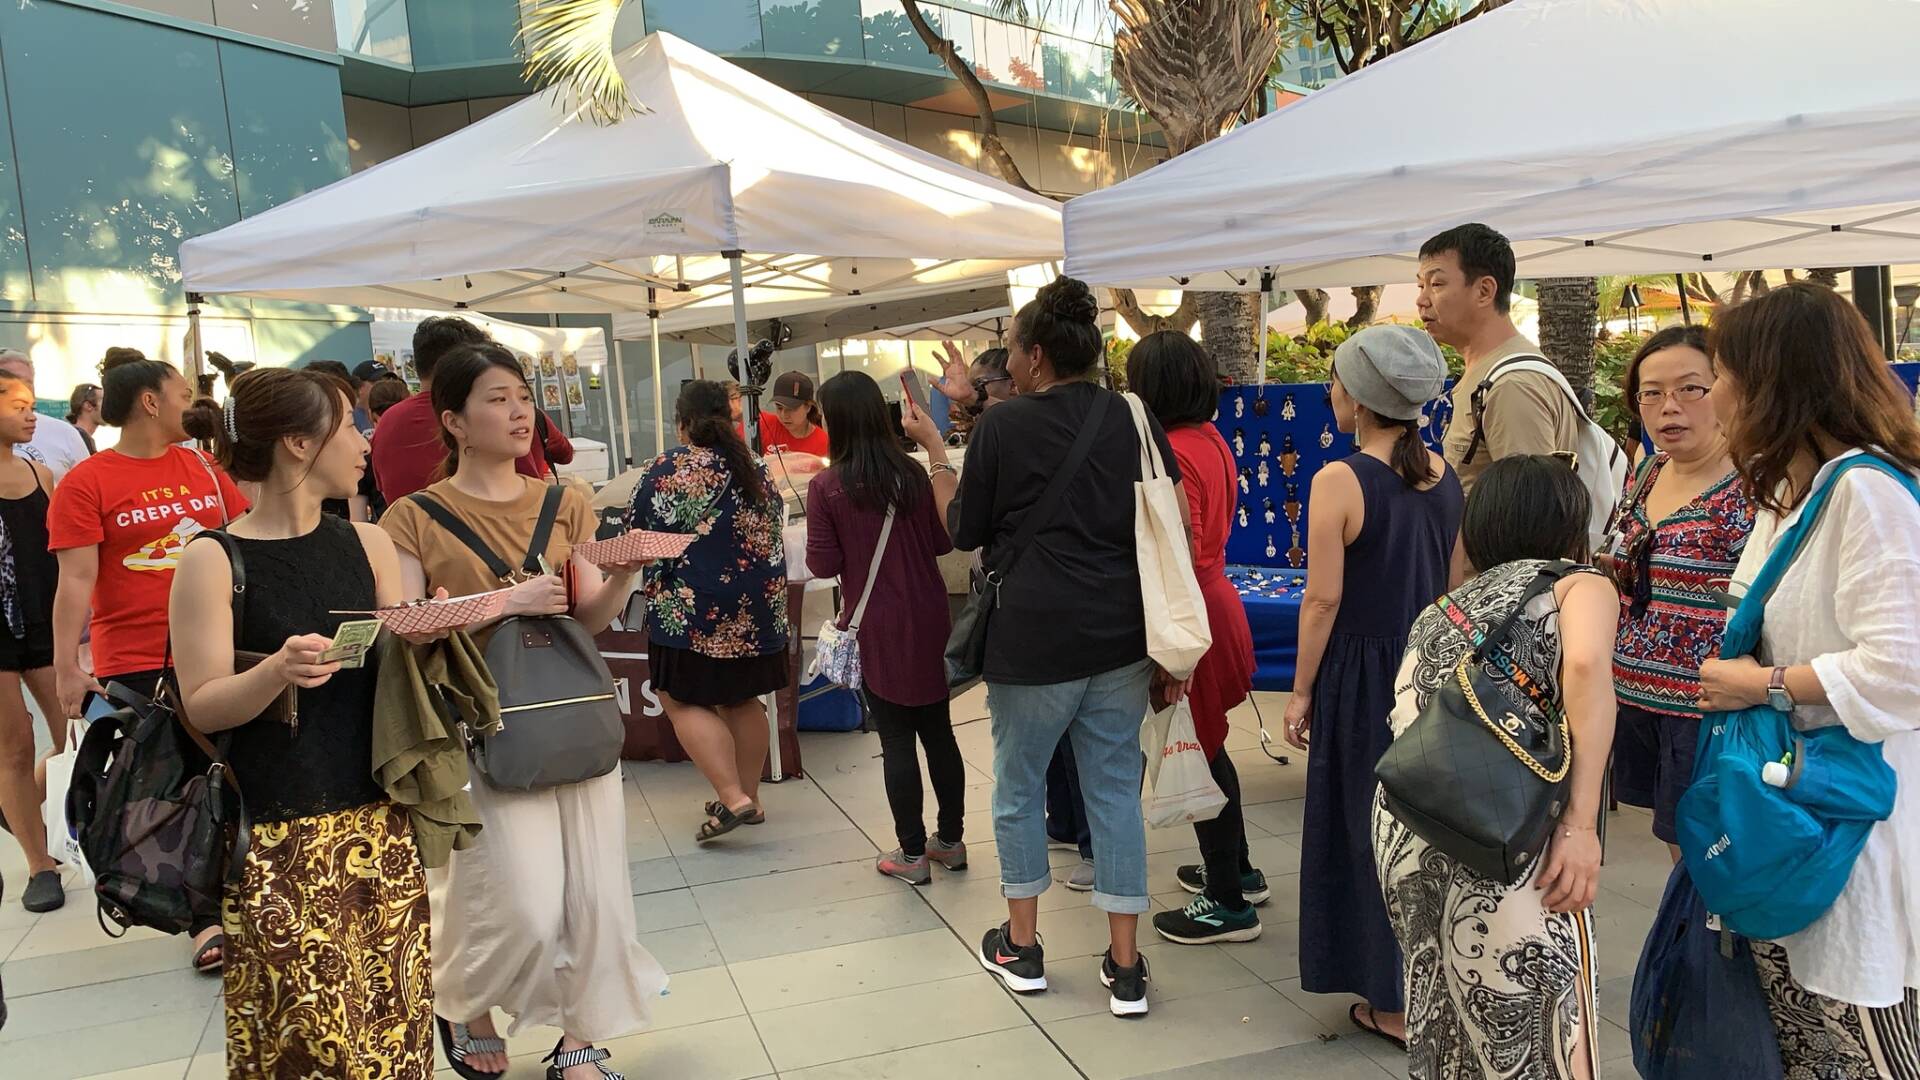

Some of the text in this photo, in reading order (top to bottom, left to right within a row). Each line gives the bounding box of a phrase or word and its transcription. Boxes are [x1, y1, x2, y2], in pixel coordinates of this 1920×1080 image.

[142, 485, 191, 502] IT'S A
[116, 502, 186, 527] CREPE
